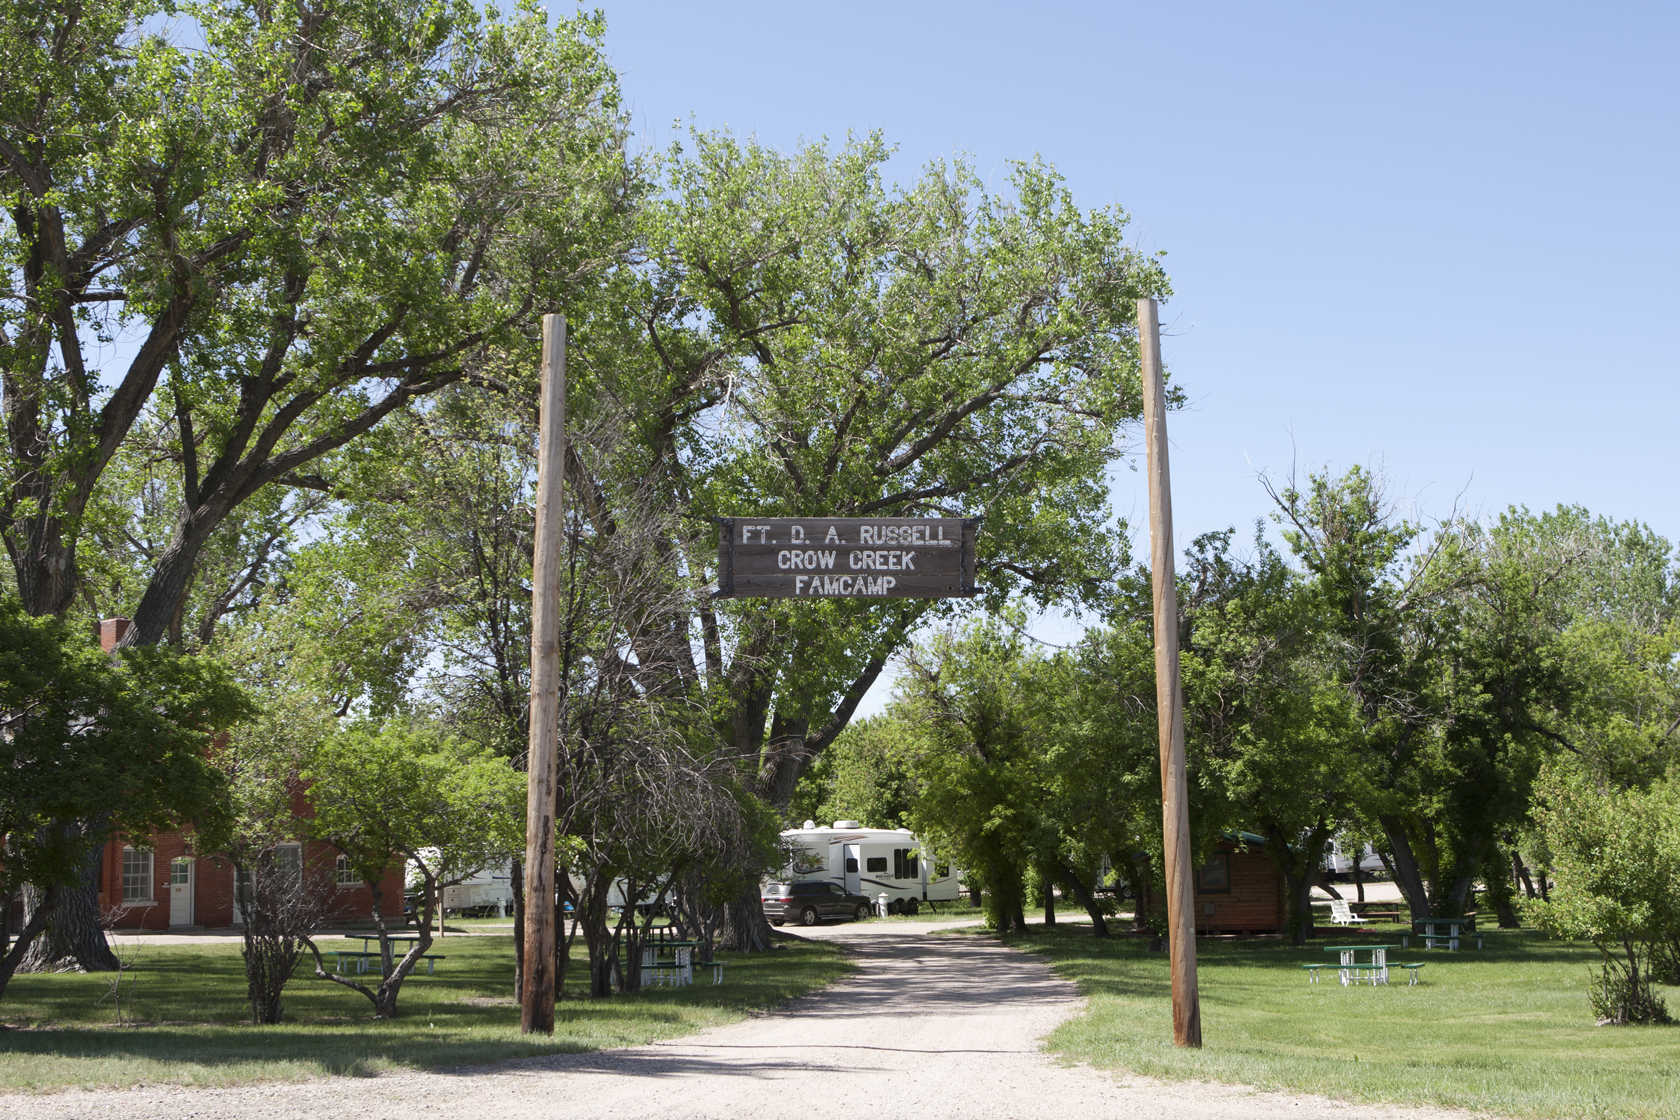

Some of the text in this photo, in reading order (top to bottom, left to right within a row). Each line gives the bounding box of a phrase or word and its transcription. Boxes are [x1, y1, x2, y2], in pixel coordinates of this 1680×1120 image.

[742, 525, 951, 546] FT. D. A. RUSSELL
[777, 550, 915, 570] CROW CREEK
[795, 575, 896, 595] FAMCAMP
